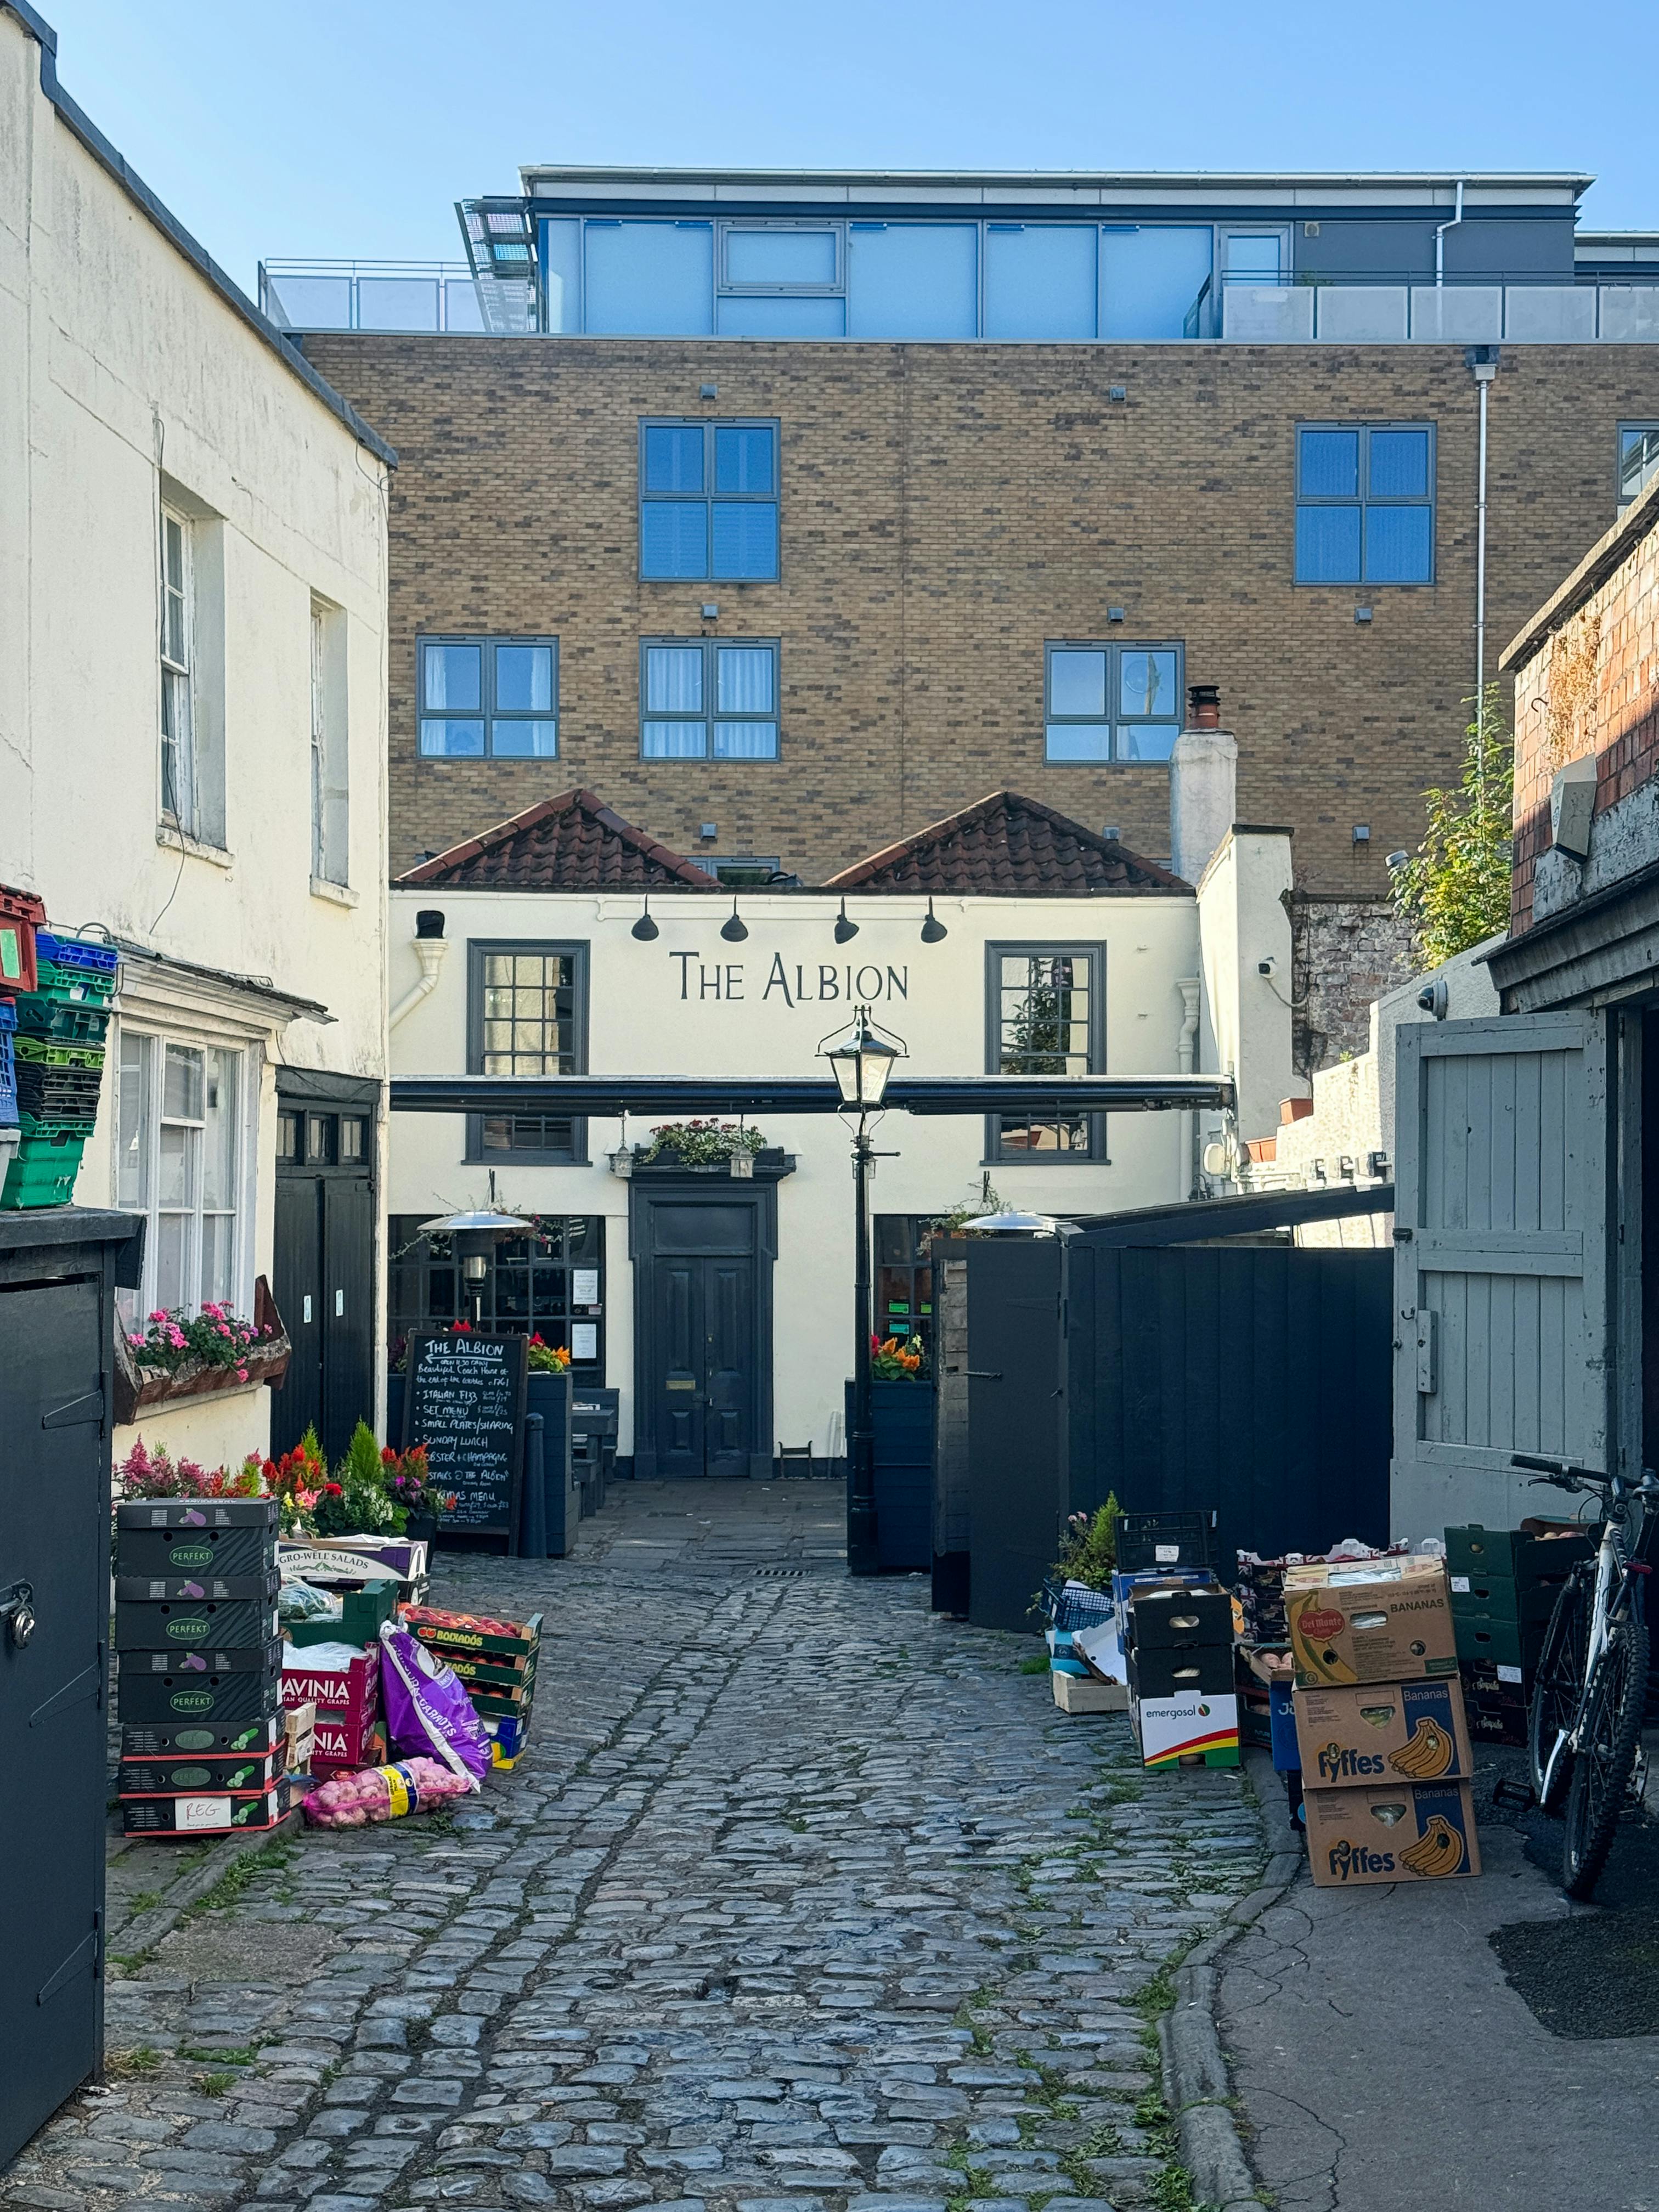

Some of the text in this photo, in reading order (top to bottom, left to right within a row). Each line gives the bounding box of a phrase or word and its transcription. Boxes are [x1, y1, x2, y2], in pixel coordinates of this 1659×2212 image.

[669, 951, 908, 1008] THE ALBION
[425, 1338, 504, 1356] THE ALBION
[423, 1390, 455, 1400] ITALIAN
[423, 1405, 439, 1415] SET
[443, 1406, 469, 1415] MENU
[421, 1419, 447, 1428] SMALL
[422, 1434, 488, 1450] SUNDAY LUNCH
[173, 1552, 210, 1560] PERFEKT
[331, 1554, 369, 1569] SALADS
[1390, 1599, 1444, 1612] BANANAS
[169, 1624, 207, 1633] PERFEKT
[1316, 1618, 1341, 1628] Monte
[437, 1630, 483, 1646] BOIXADÓS
[1404, 1689, 1448, 1701] Bananas
[173, 1697, 211, 1706] PERFEKT
[419, 1699, 456, 1737] CARROTS
[1146, 1705, 1195, 1719] emergosol
[1415, 1788, 1459, 1799] Bananas
[187, 1803, 221, 1820] REG
